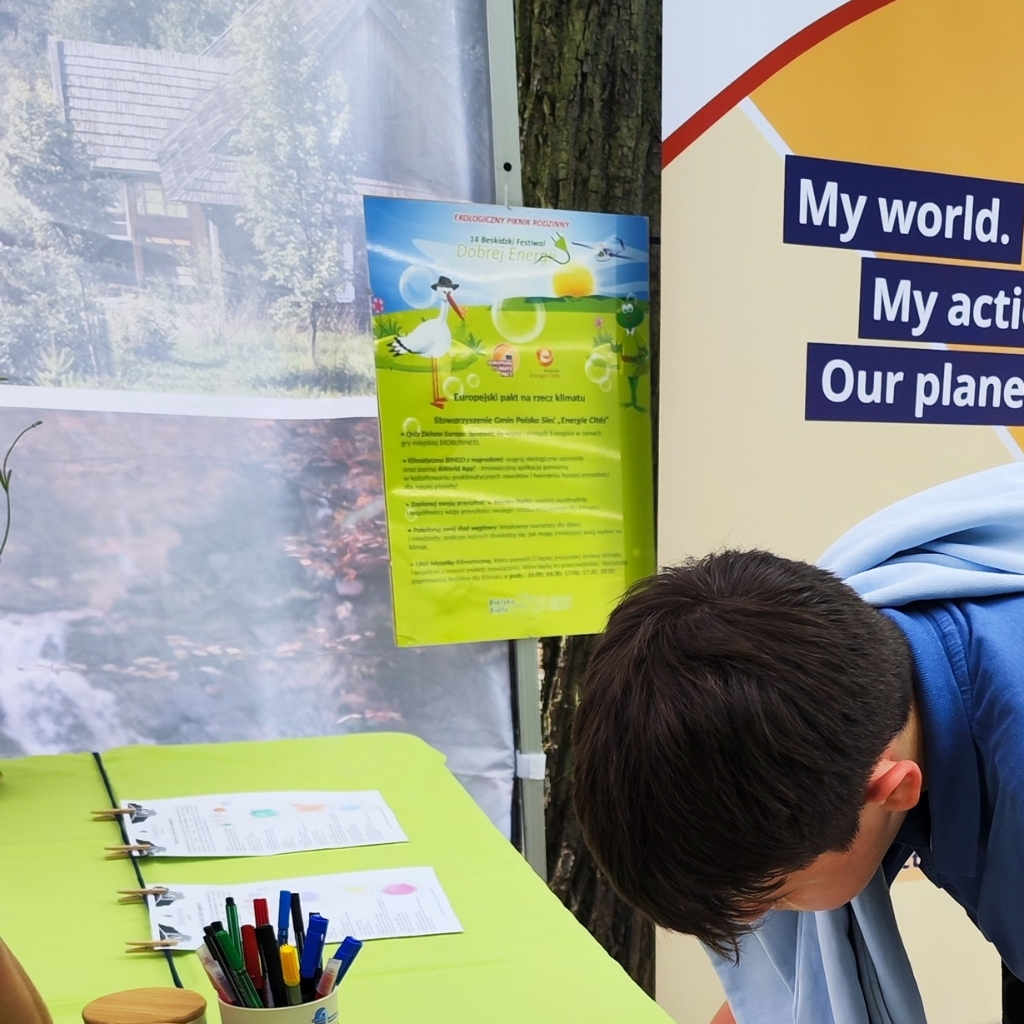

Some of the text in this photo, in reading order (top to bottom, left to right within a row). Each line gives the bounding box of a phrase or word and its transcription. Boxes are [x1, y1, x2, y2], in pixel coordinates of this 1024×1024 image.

[798, 177, 1010, 245] My world.
[453, 213, 570, 229] EKOLOGICZNY PIKNIK RODZINNY
[480, 235, 515, 246] Beskidzki
[515, 238, 546, 247] Festiwal
[457, 244, 505, 263] Dobrej
[873, 277, 939, 337] My
[821, 358, 905, 405] Our
[452, 391, 499, 403] Europejski
[499, 393, 519, 403] pakt
[532, 395, 554, 403] rzecz
[554, 393, 586, 403] klimatu
[493, 416, 515, 425] Gmin
[515, 416, 540, 424] Polska
